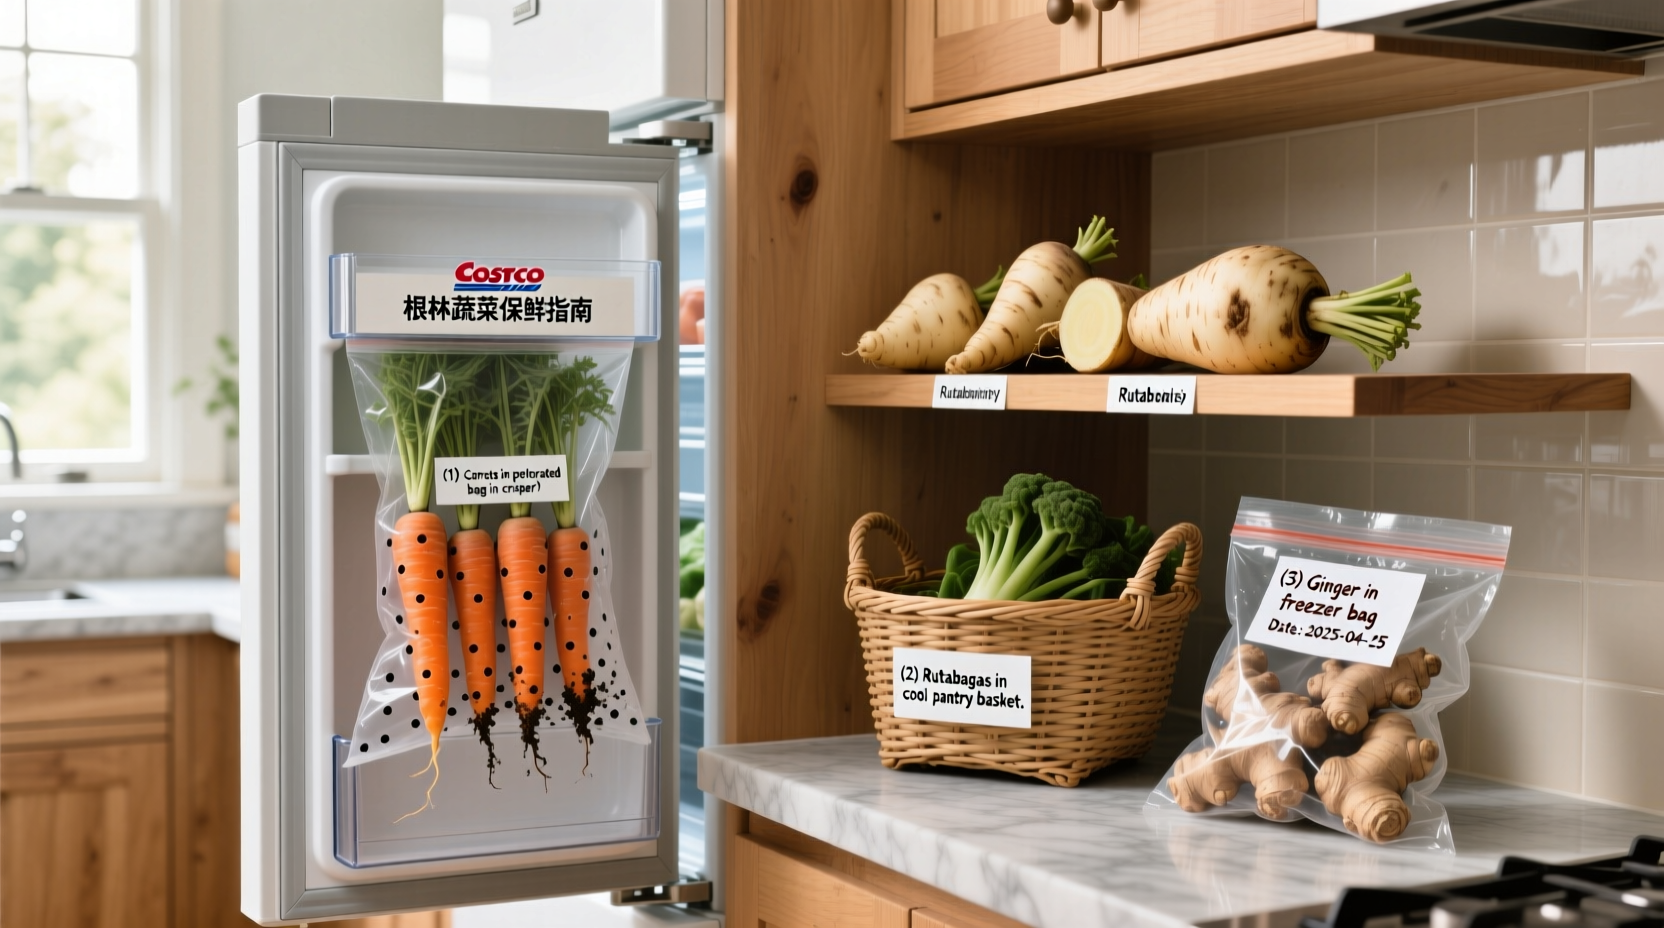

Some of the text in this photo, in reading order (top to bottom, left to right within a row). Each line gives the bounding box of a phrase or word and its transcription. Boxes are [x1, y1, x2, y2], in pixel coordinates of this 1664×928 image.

[403, 294, 593, 324] 根林蔬菜保鲜指南
[443, 467, 460, 483] (1)
[501, 468, 510, 479] in
[489, 483, 498, 494] in
[1280, 568, 1379, 600] (3) Ginger in
[1279, 593, 1378, 630] freezer bag
[900, 665, 1007, 690] (2) Rutabagas in
[902, 688, 1025, 710] cool pantry basket.
